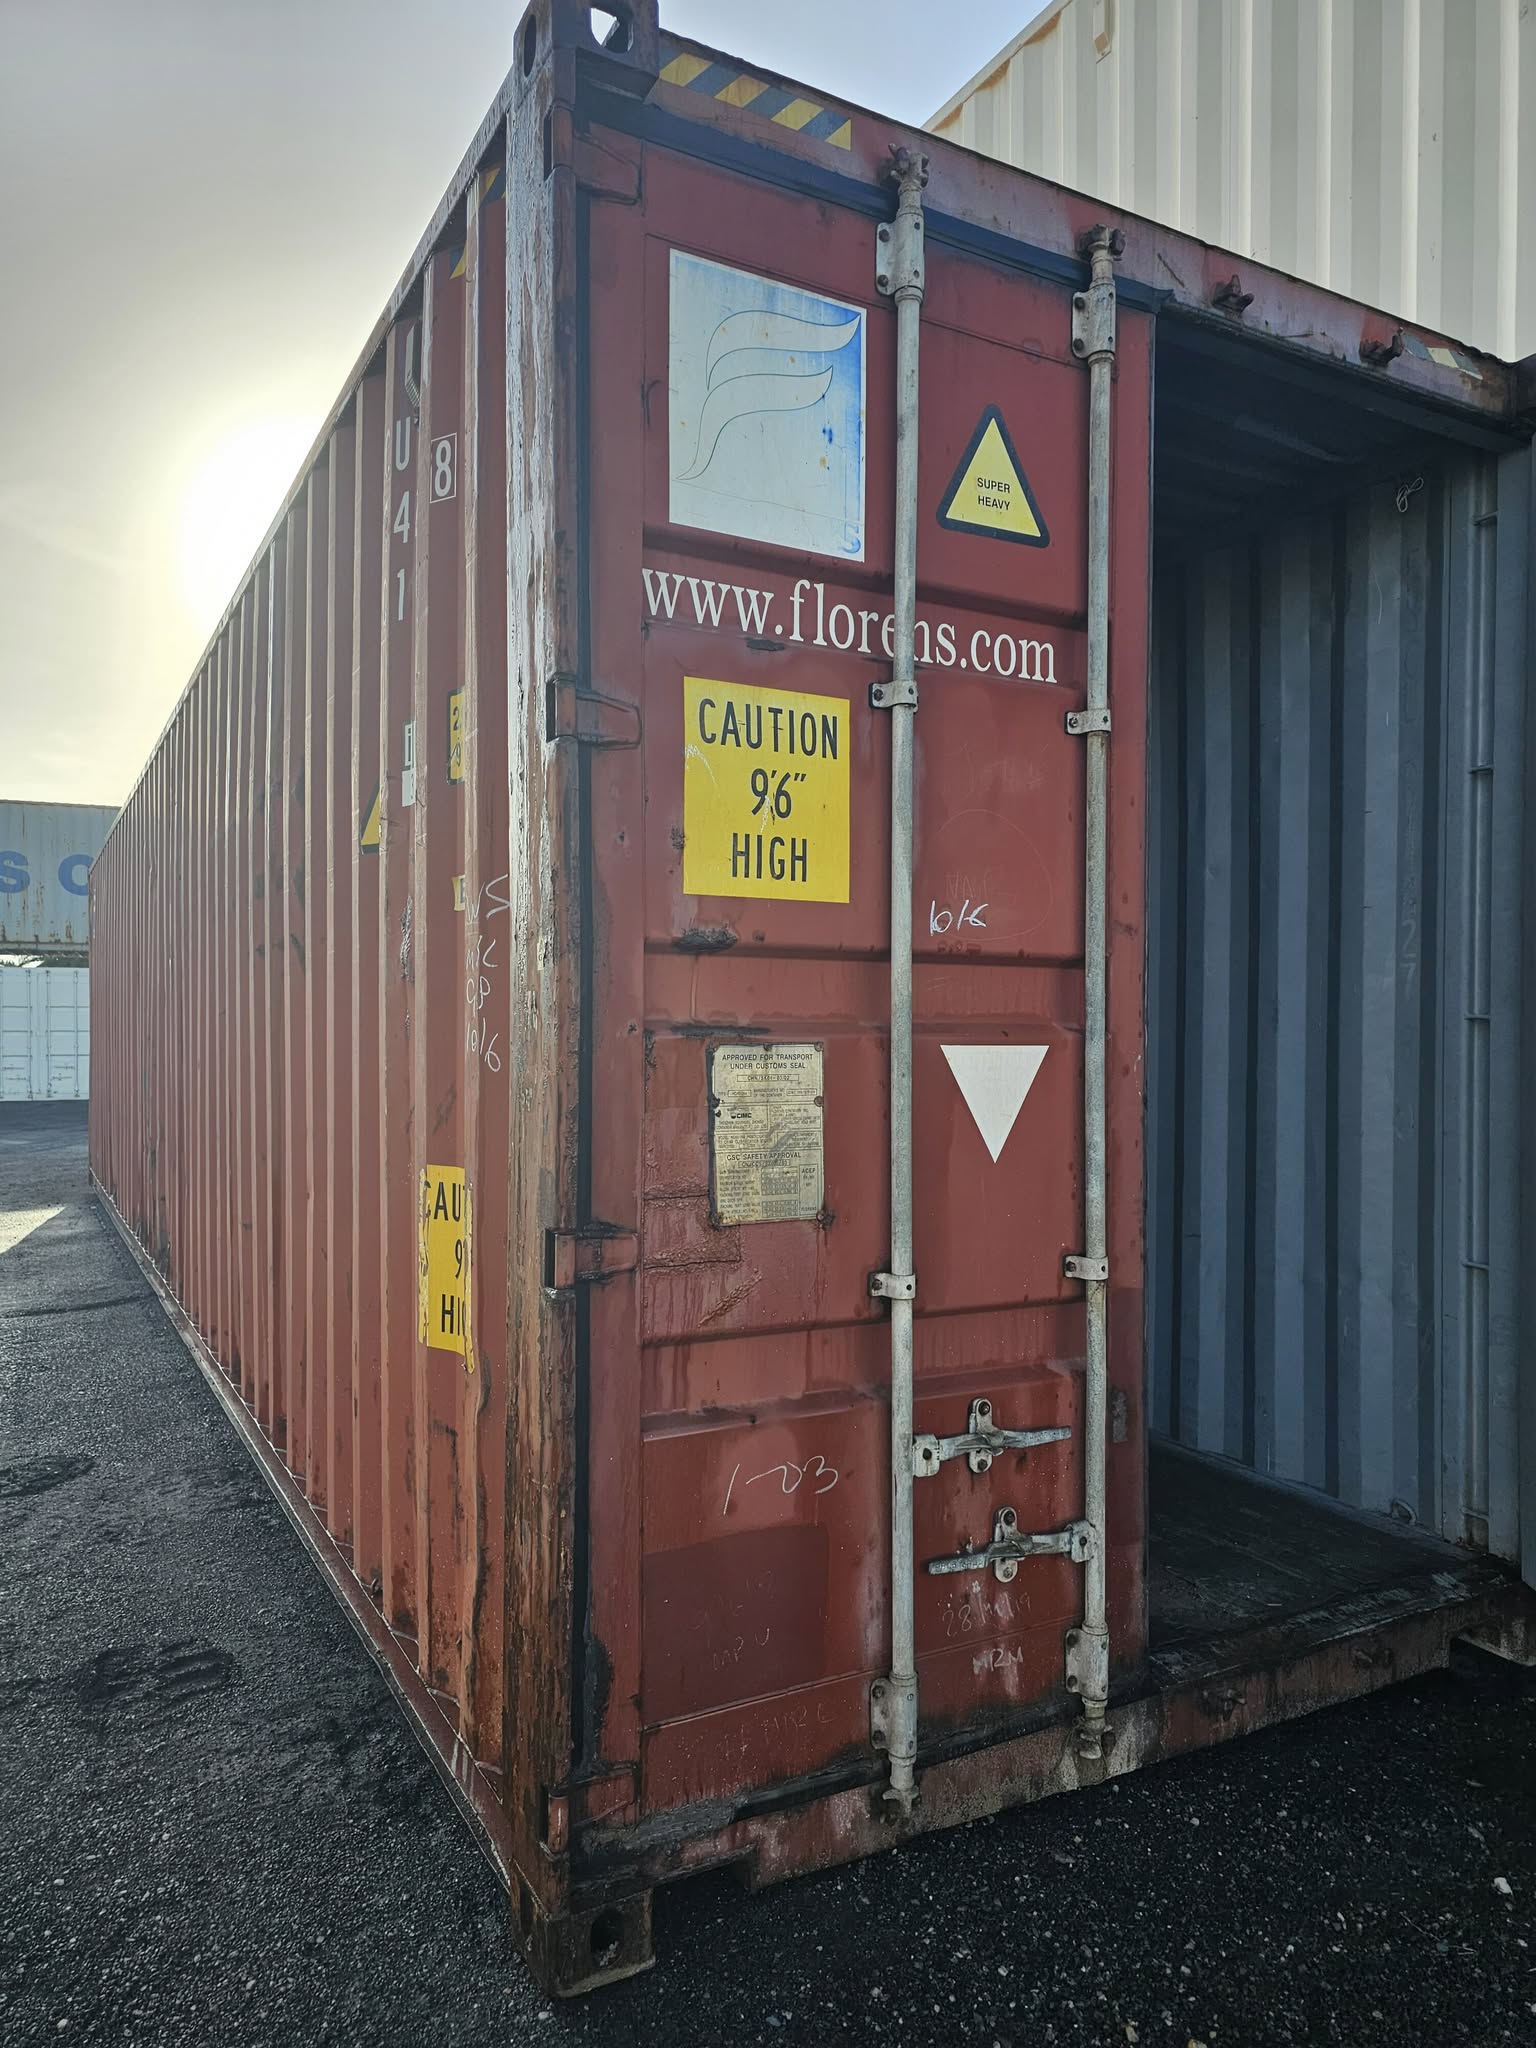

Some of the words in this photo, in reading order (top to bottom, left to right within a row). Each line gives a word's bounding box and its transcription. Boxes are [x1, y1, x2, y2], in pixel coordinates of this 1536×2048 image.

[977, 477, 1010, 494] SUPER
[977, 496, 1010, 511] HEAVY
[642, 568, 1057, 684] www.florens.com
[698, 698, 838, 760] CAUTION
[732, 832, 807, 882] HIGH
[776, 1053, 813, 1061] TRANSPORT
[730, 1062, 753, 1070] UNDER
[755, 1062, 787, 1070] CUSTOMS
[742, 1153, 767, 1161] SAFETY
[769, 1151, 801, 1159] APPROVAL
